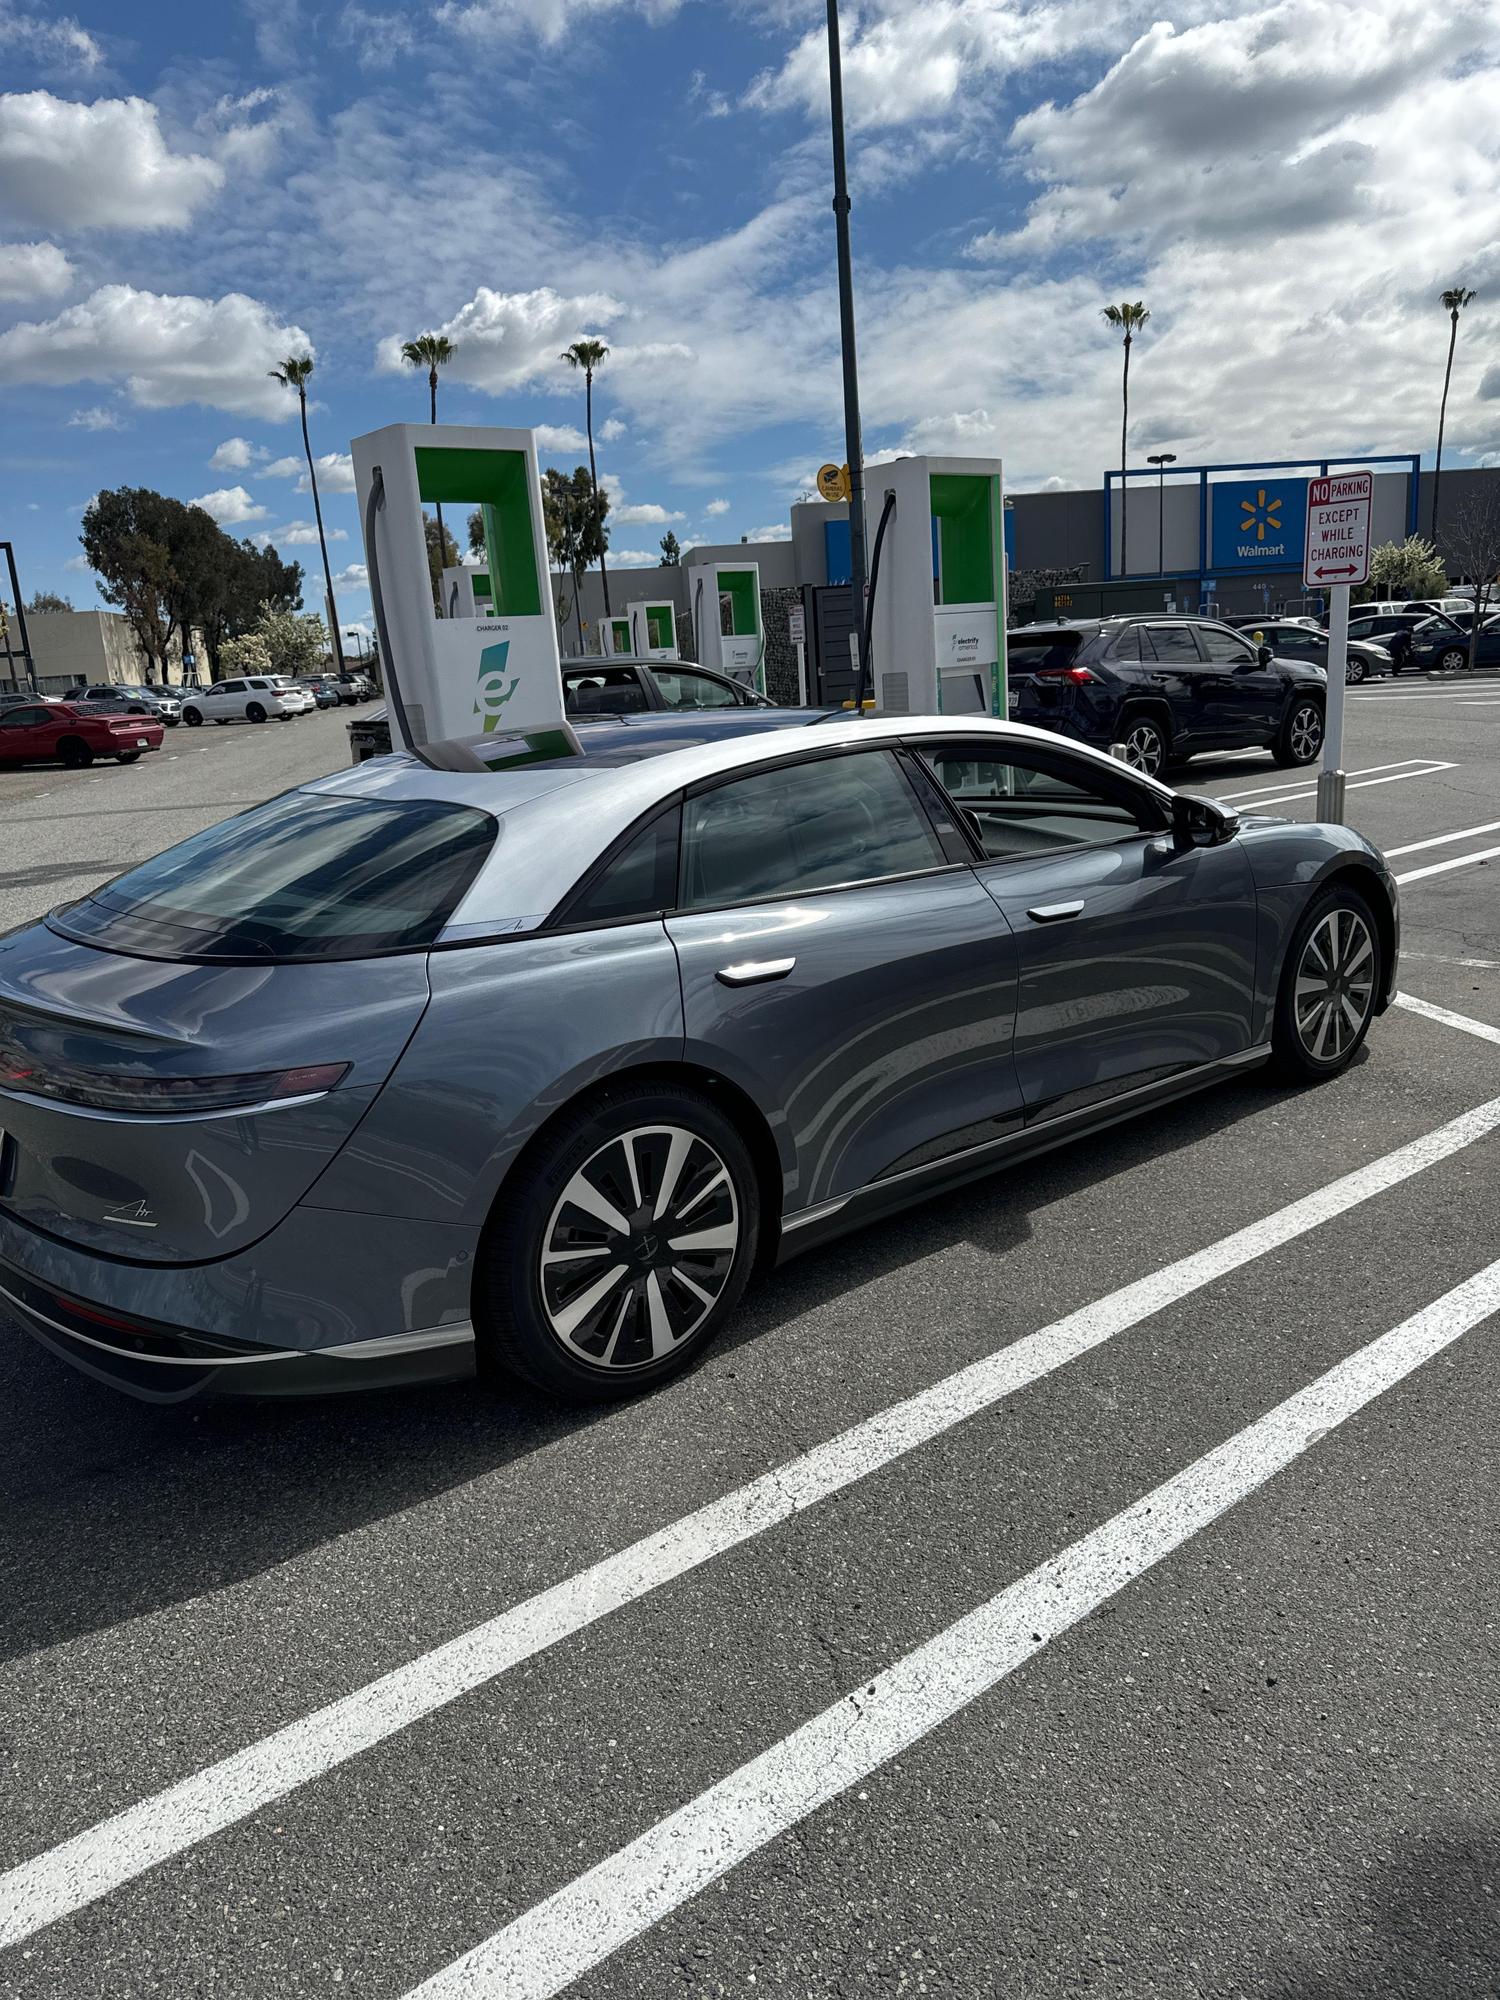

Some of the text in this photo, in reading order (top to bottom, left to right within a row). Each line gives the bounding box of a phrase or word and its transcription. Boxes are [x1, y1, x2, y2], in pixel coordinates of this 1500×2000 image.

[1313, 480, 1368, 502] NO PARKING
[1319, 508, 1359, 525] EXCEPT
[1321, 527, 1354, 542] WHILE
[1237, 543, 1284, 557] Walmart
[1311, 545, 1363, 561] CHARGING
[957, 637, 979, 645] electrify
[104, 1199, 153, 1217] Air
